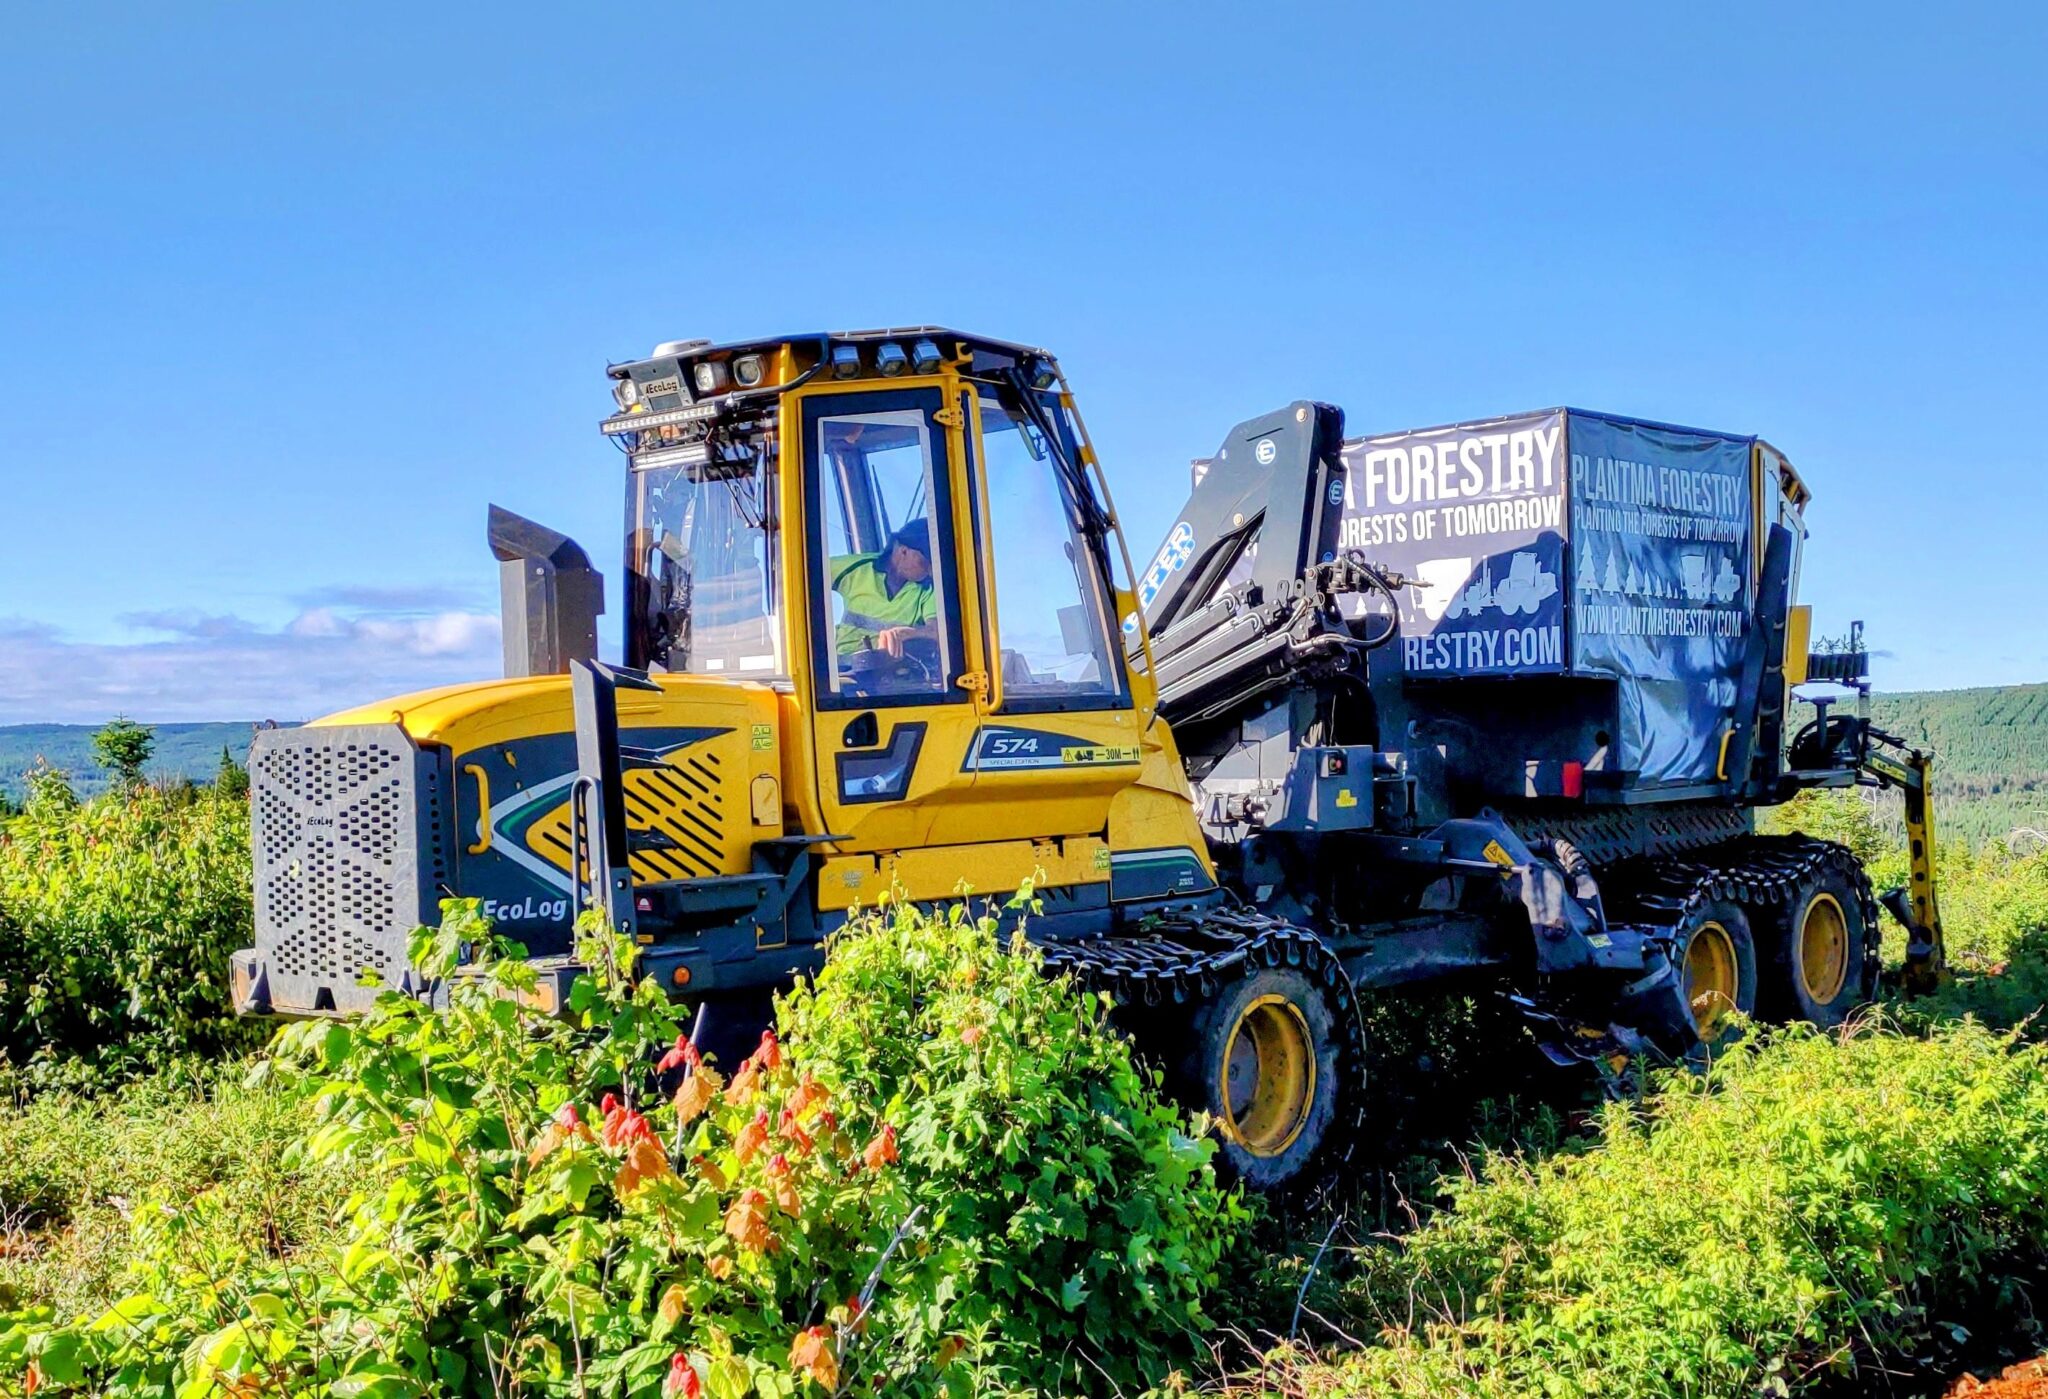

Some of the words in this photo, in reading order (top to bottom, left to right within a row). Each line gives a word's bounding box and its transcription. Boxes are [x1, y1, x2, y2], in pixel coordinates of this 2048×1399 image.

[648, 381, 678, 394] EcoLog
[1366, 427, 1560, 508] FORESTRY
[1572, 454, 1656, 507] PLANTMA
[1660, 467, 1742, 517] FORESTRY
[1412, 508, 1438, 541] OF
[1442, 495, 1561, 537] TOMORROW
[1574, 505, 1621, 532] PLANTING
[1623, 508, 1640, 534] THE
[1641, 513, 1678, 539] FORESTS
[1680, 517, 1692, 540] OF
[1694, 517, 1744, 545] TOMORROW
[1576, 604, 1742, 638] WWW.PLANTMAFORESTRY.COM
[1401, 626, 1561, 670] RESTRY.COM
[992, 738, 1038, 753] 574
[1105, 748, 1121, 760] 30M
[482, 896, 567, 921] EcoLog
